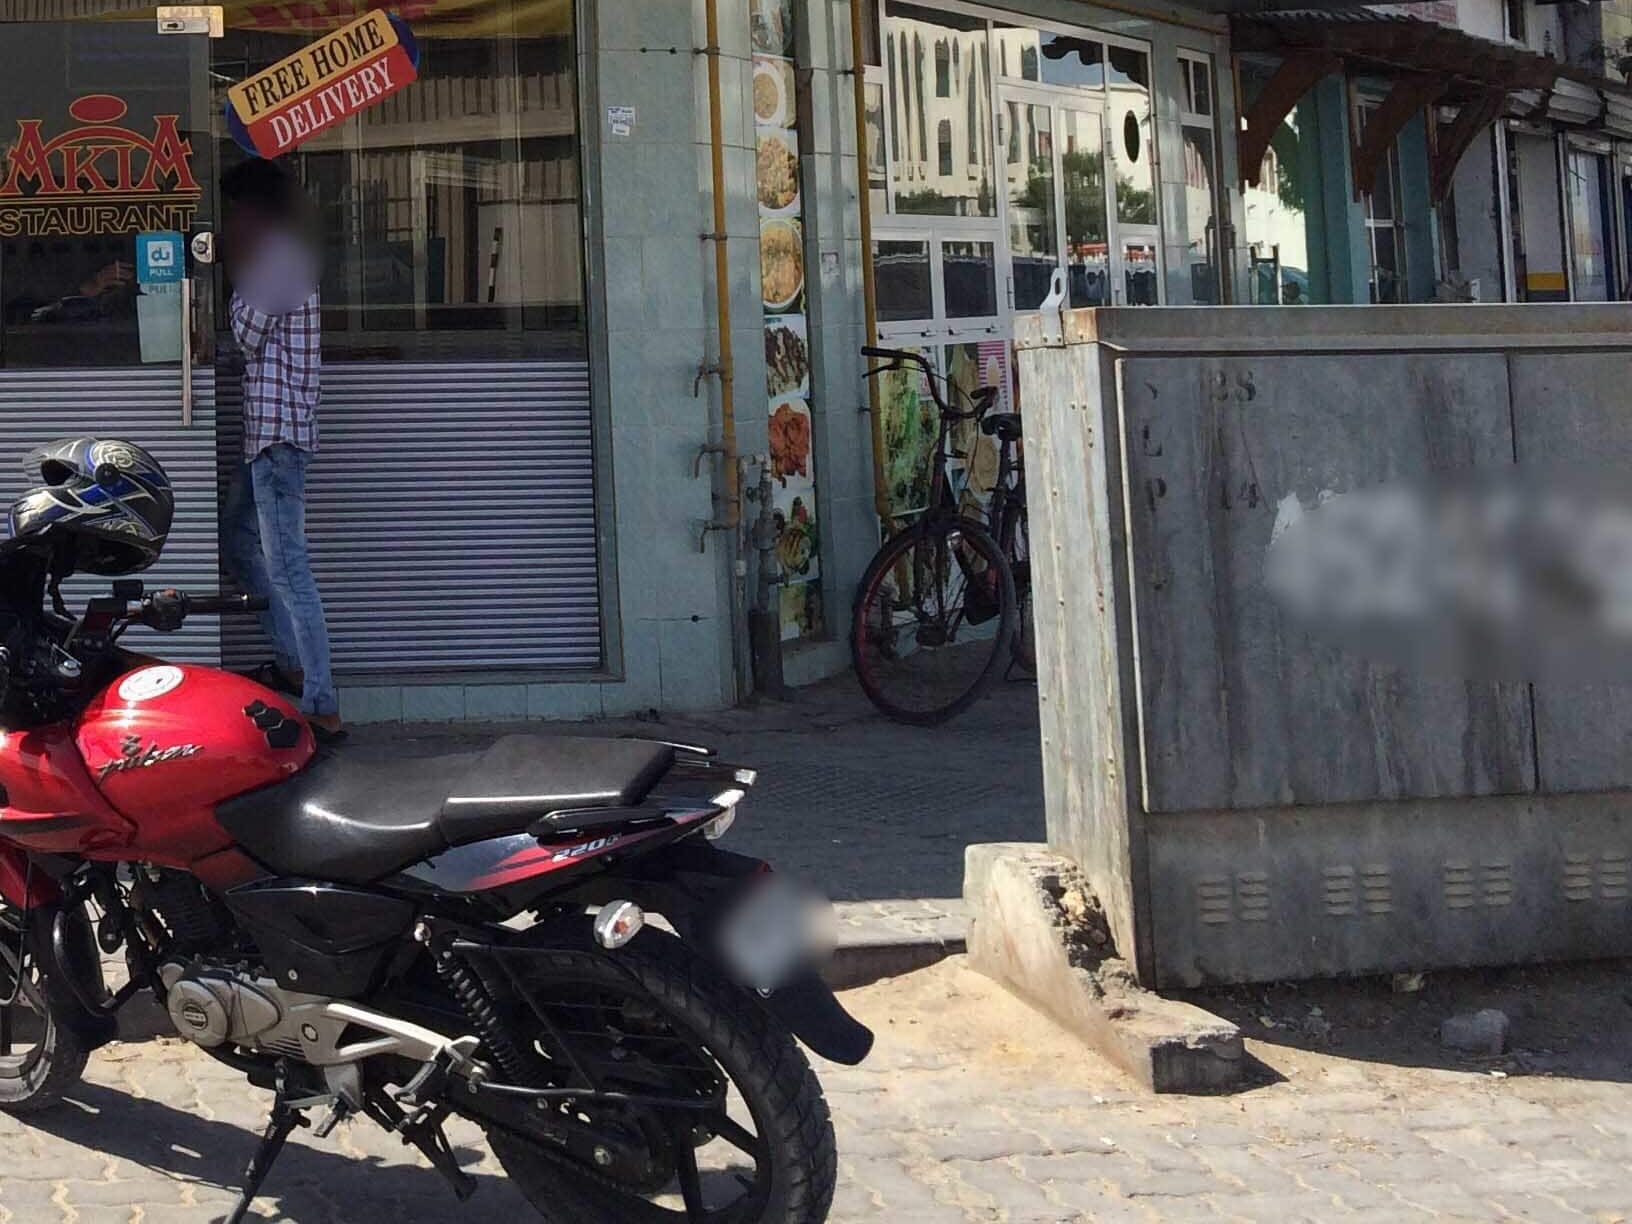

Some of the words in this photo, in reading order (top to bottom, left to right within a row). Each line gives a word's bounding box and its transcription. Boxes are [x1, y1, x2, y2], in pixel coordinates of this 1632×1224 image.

[241, 58, 309, 116] FREE
[309, 18, 386, 77] HOME
[269, 57, 396, 149] DELIVERY
